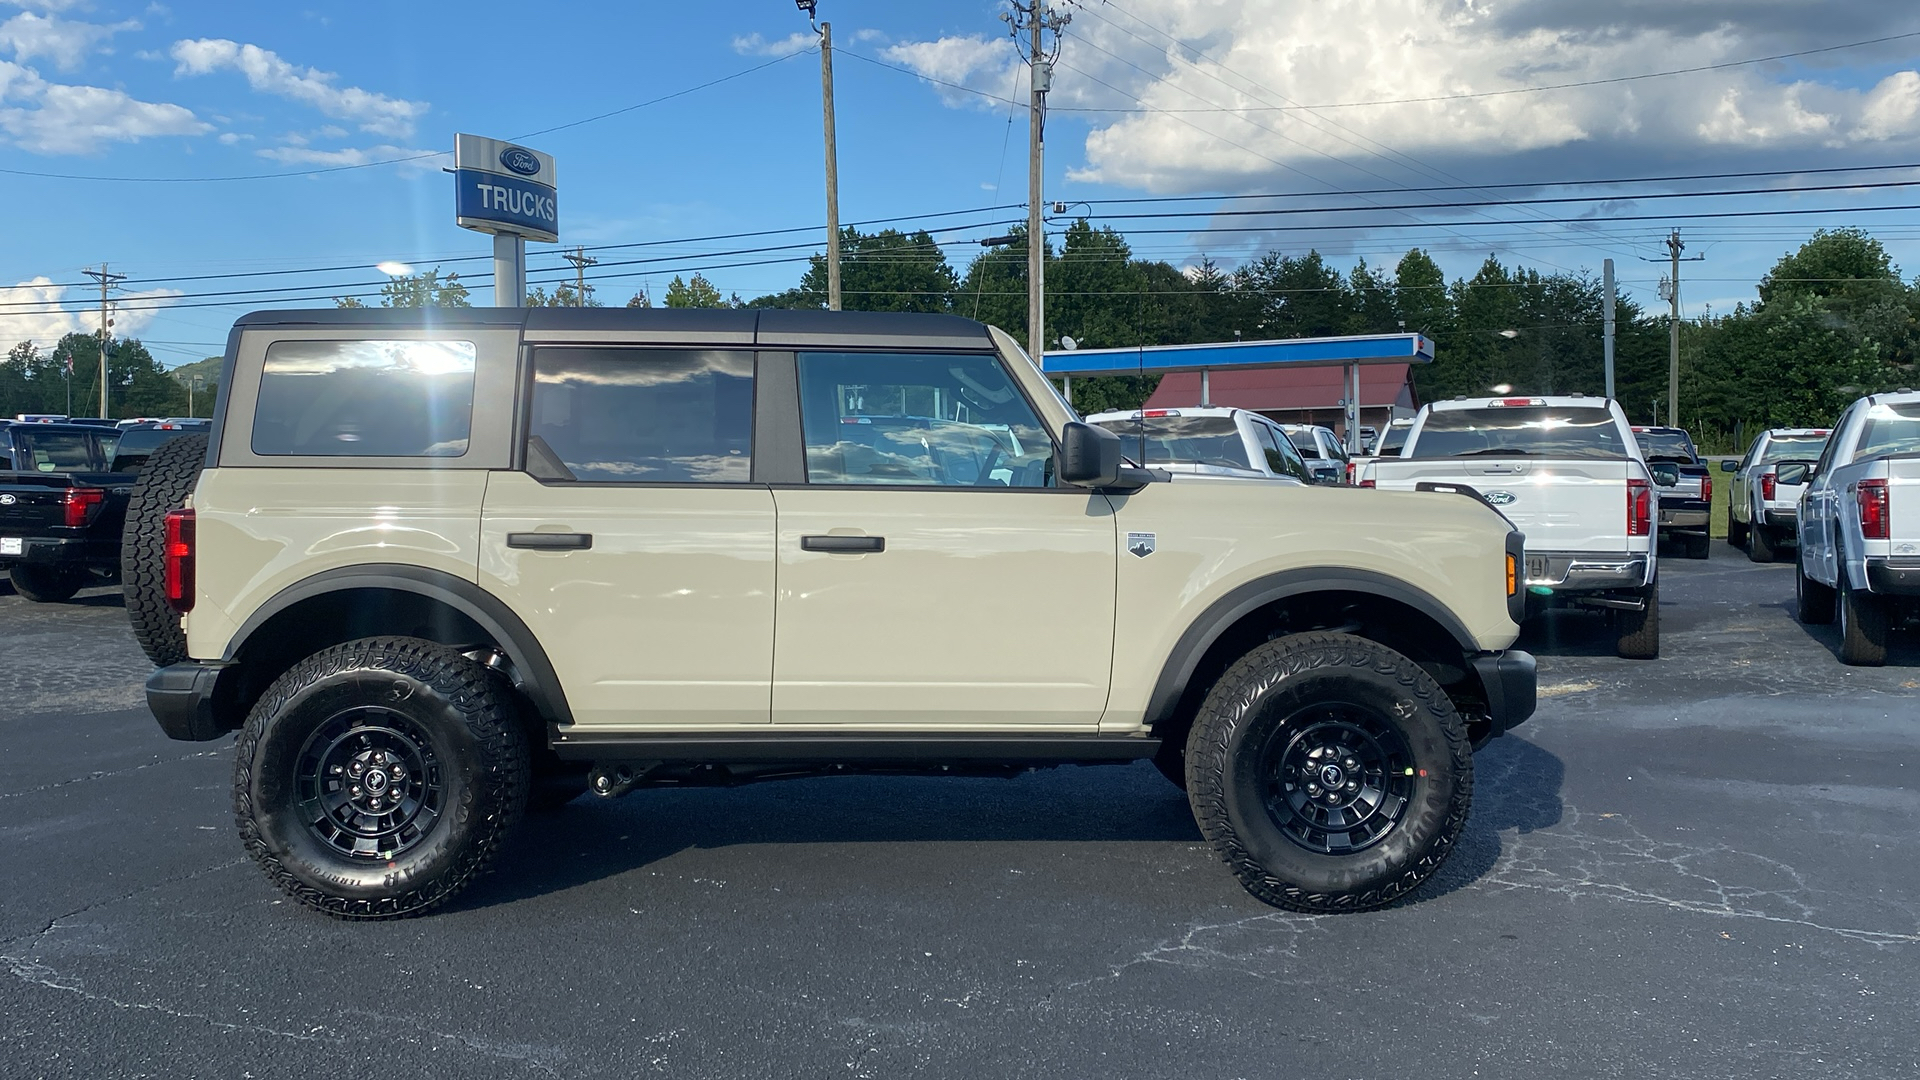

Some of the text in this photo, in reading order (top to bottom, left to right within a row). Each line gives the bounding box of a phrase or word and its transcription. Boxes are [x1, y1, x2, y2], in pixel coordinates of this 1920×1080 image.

[513, 153, 534, 171] Ford
[477, 183, 555, 222] TRUCKS
[1487, 493, 1510, 504] Ford
